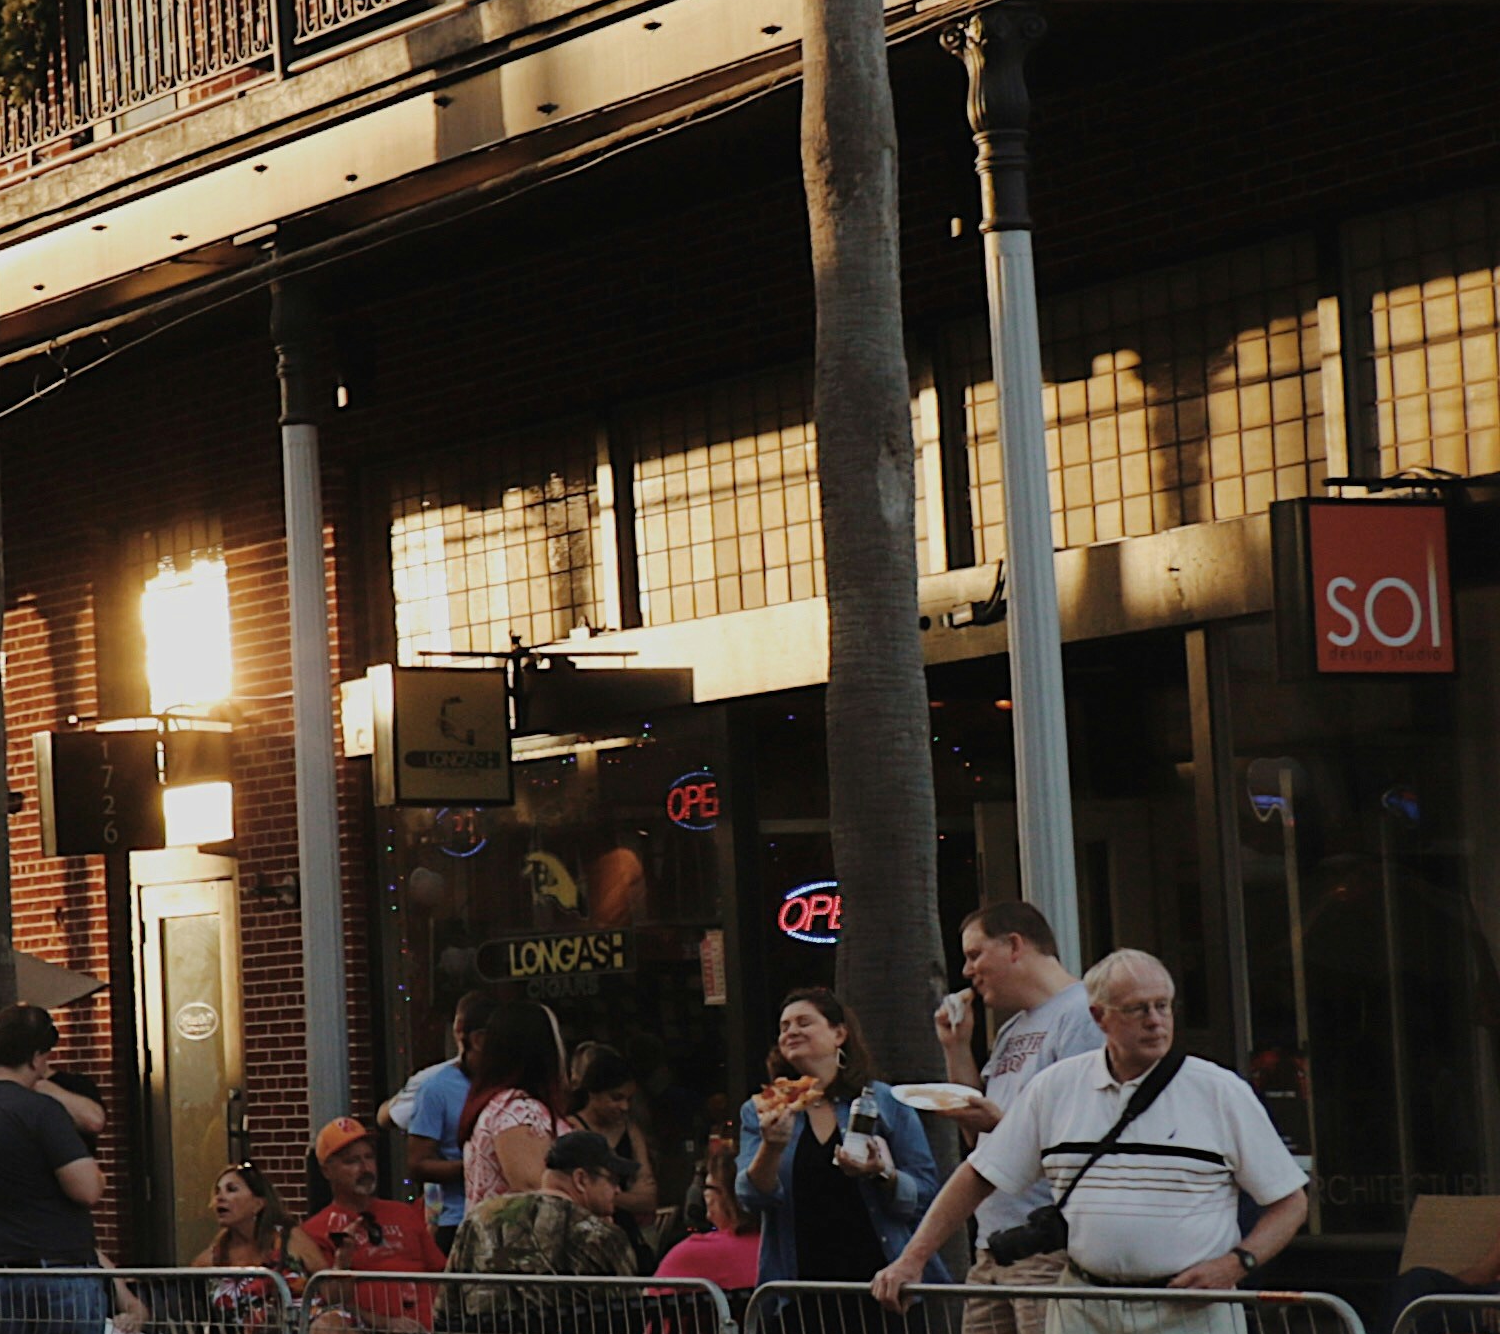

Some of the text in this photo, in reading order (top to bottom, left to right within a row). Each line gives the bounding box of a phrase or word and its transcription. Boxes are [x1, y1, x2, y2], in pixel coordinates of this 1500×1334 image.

[1326, 539, 1442, 648] sol
[1329, 647, 1443, 665] design studio
[665, 780, 720, 823] OPE
[776, 893, 844, 934] OPE
[508, 932, 626, 978] LONGASH
[1315, 1171, 1498, 1205] RCHITECTURE
